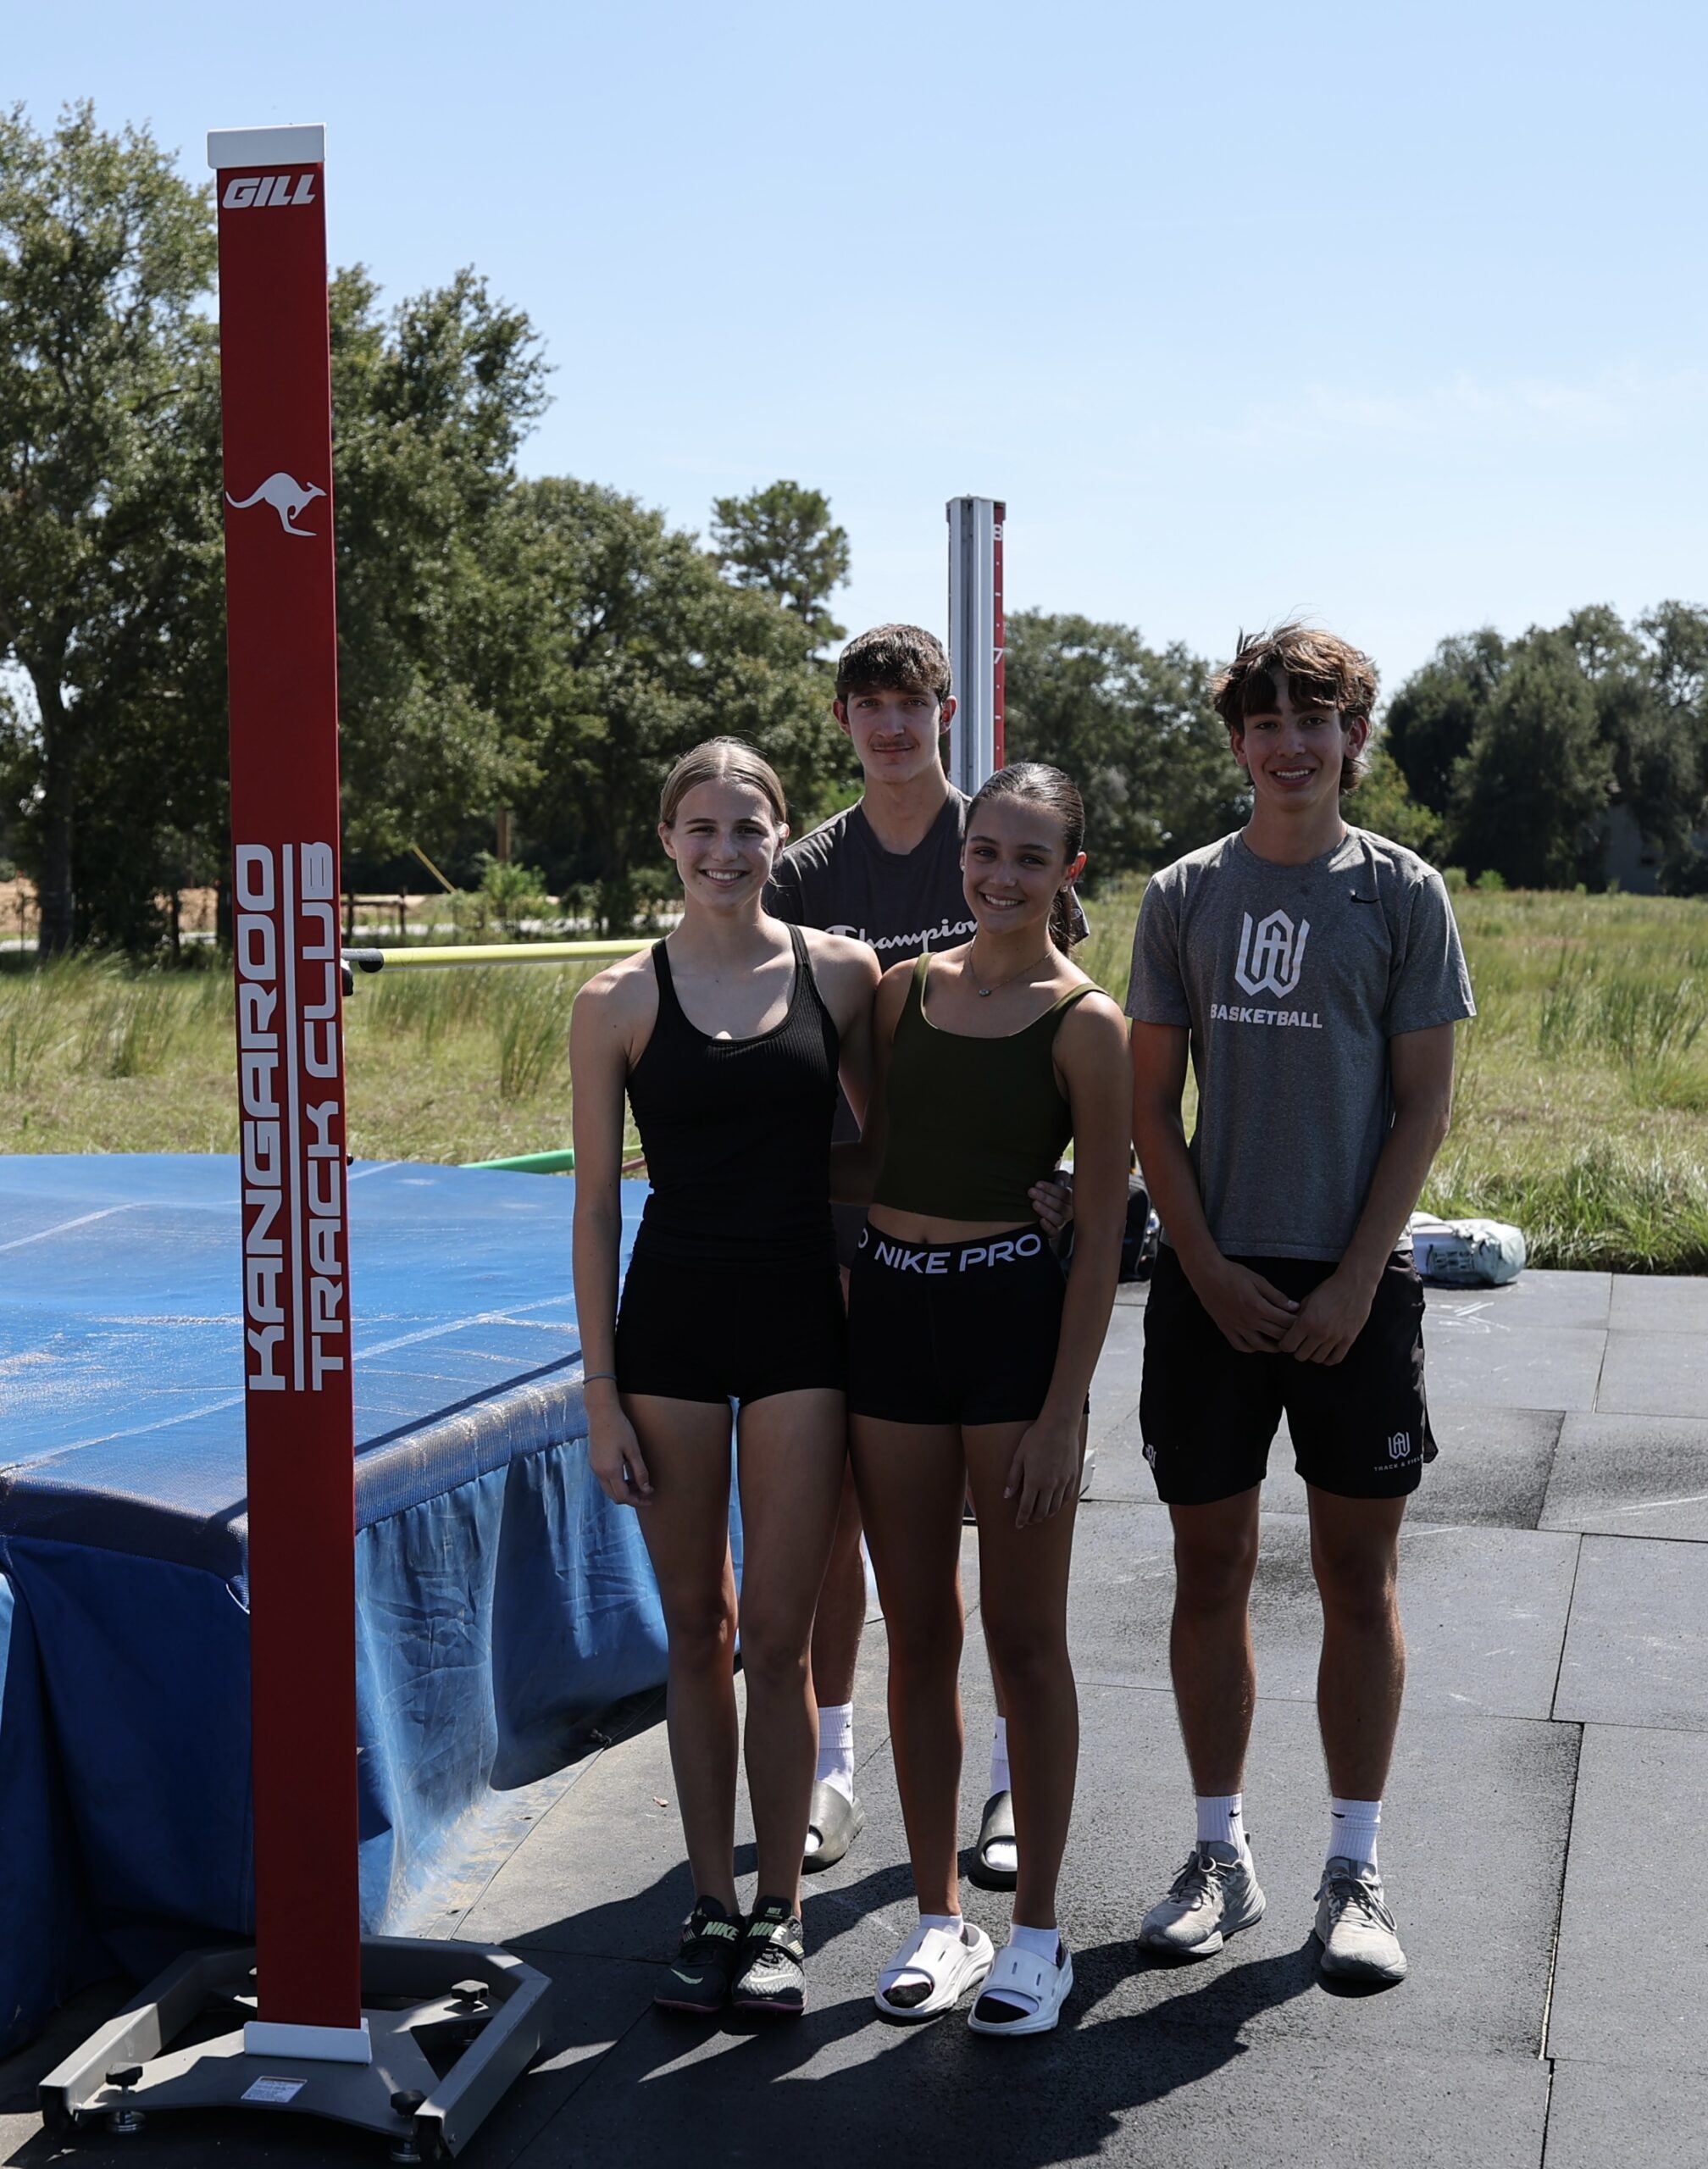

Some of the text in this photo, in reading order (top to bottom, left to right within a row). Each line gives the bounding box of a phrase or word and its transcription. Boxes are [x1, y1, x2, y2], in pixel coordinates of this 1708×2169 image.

[222, 174, 316, 209] GILL
[993, 647, 1004, 665] 7
[1210, 1003, 1323, 1029] BASKETBALL
[236, 844, 286, 1390] KANGAROO
[300, 841, 344, 1391] TRACK CLUB
[873, 1241, 951, 1274] NIKE
[959, 1234, 1041, 1272] PRO
[1373, 1463, 1398, 1472] TRACK
[701, 1921, 740, 1941] NIKE
[746, 1922, 787, 1940] NIKE
